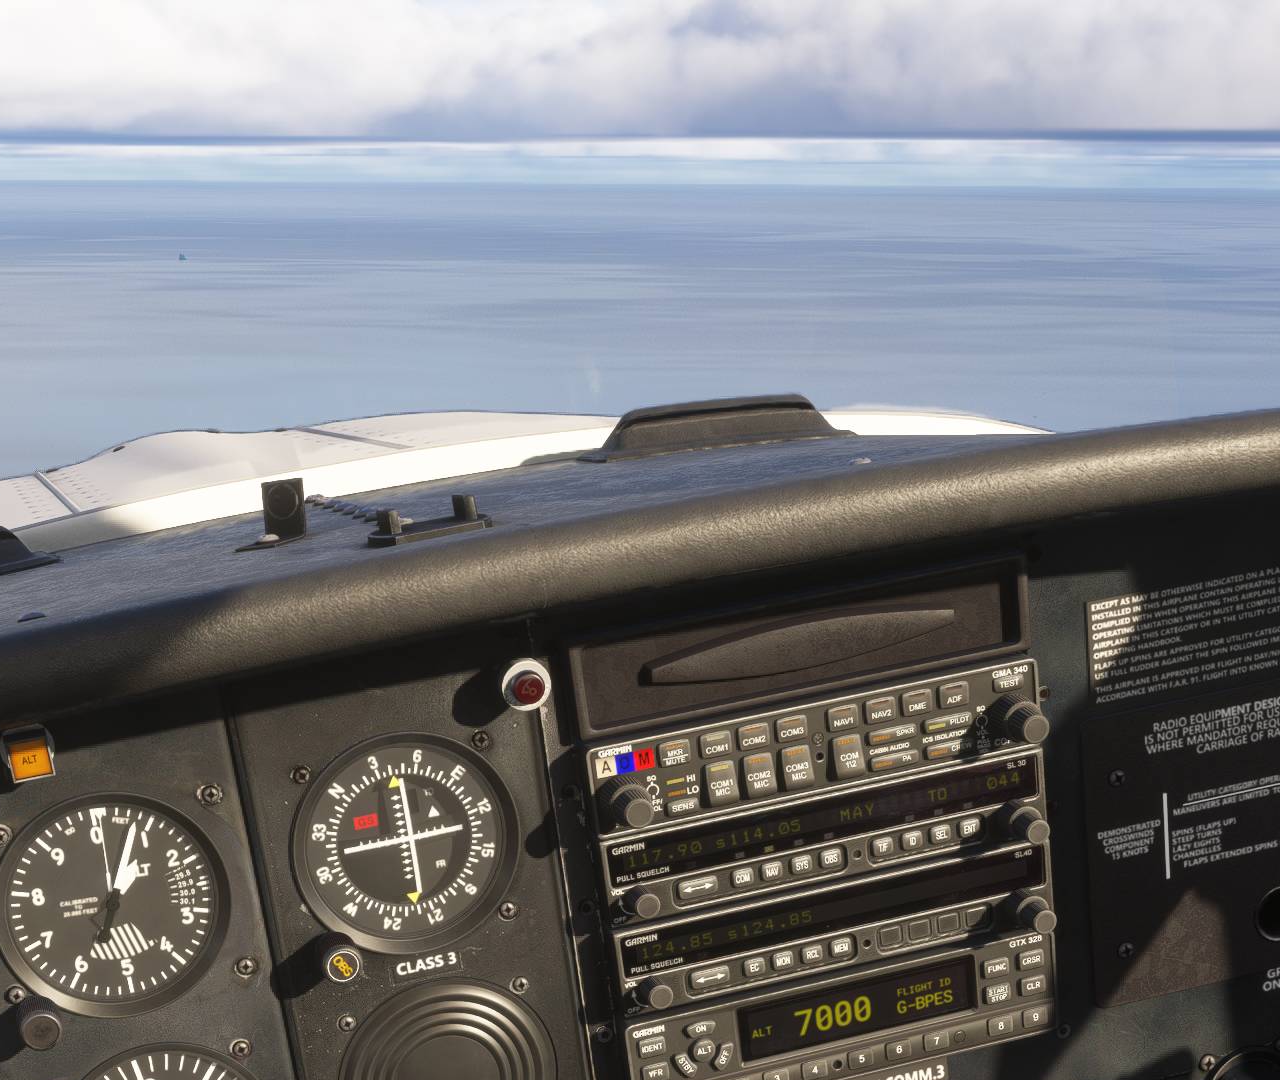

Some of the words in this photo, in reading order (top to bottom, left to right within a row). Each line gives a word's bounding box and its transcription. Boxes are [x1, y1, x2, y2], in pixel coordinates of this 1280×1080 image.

[992, 668, 1013, 679] GMA
[1014, 665, 1028, 675] 340
[999, 679, 1019, 688] TEST
[947, 695, 962, 704] ADF
[909, 702, 927, 712] DME
[872, 709, 892, 720] NAV2
[1153, 717, 1187, 732] RADIO
[1189, 703, 1251, 724] EQUIPMENT
[833, 718, 854, 727] NAV1
[949, 716, 969, 725] PILOT
[780, 727, 804, 738] COM3
[742, 735, 766, 747] COM2
[1196, 736, 1248, 753] CARRIAGE
[1251, 731, 1265, 742] OF
[705, 743, 729, 755] COM1
[22, 755, 37, 765] ALT
[686, 774, 696, 782] HI
[687, 785, 699, 794] LO
[672, 802, 694, 812] SENS
[396, 956, 439, 976] CLASS
[444, 953, 456, 965] 3
[897, 982, 931, 996] FLIGHT
[939, 978, 951, 987] ID
[897, 990, 953, 1014] G-BPES
[794, 995, 871, 1037] 7000
[752, 1026, 773, 1039] ALT
